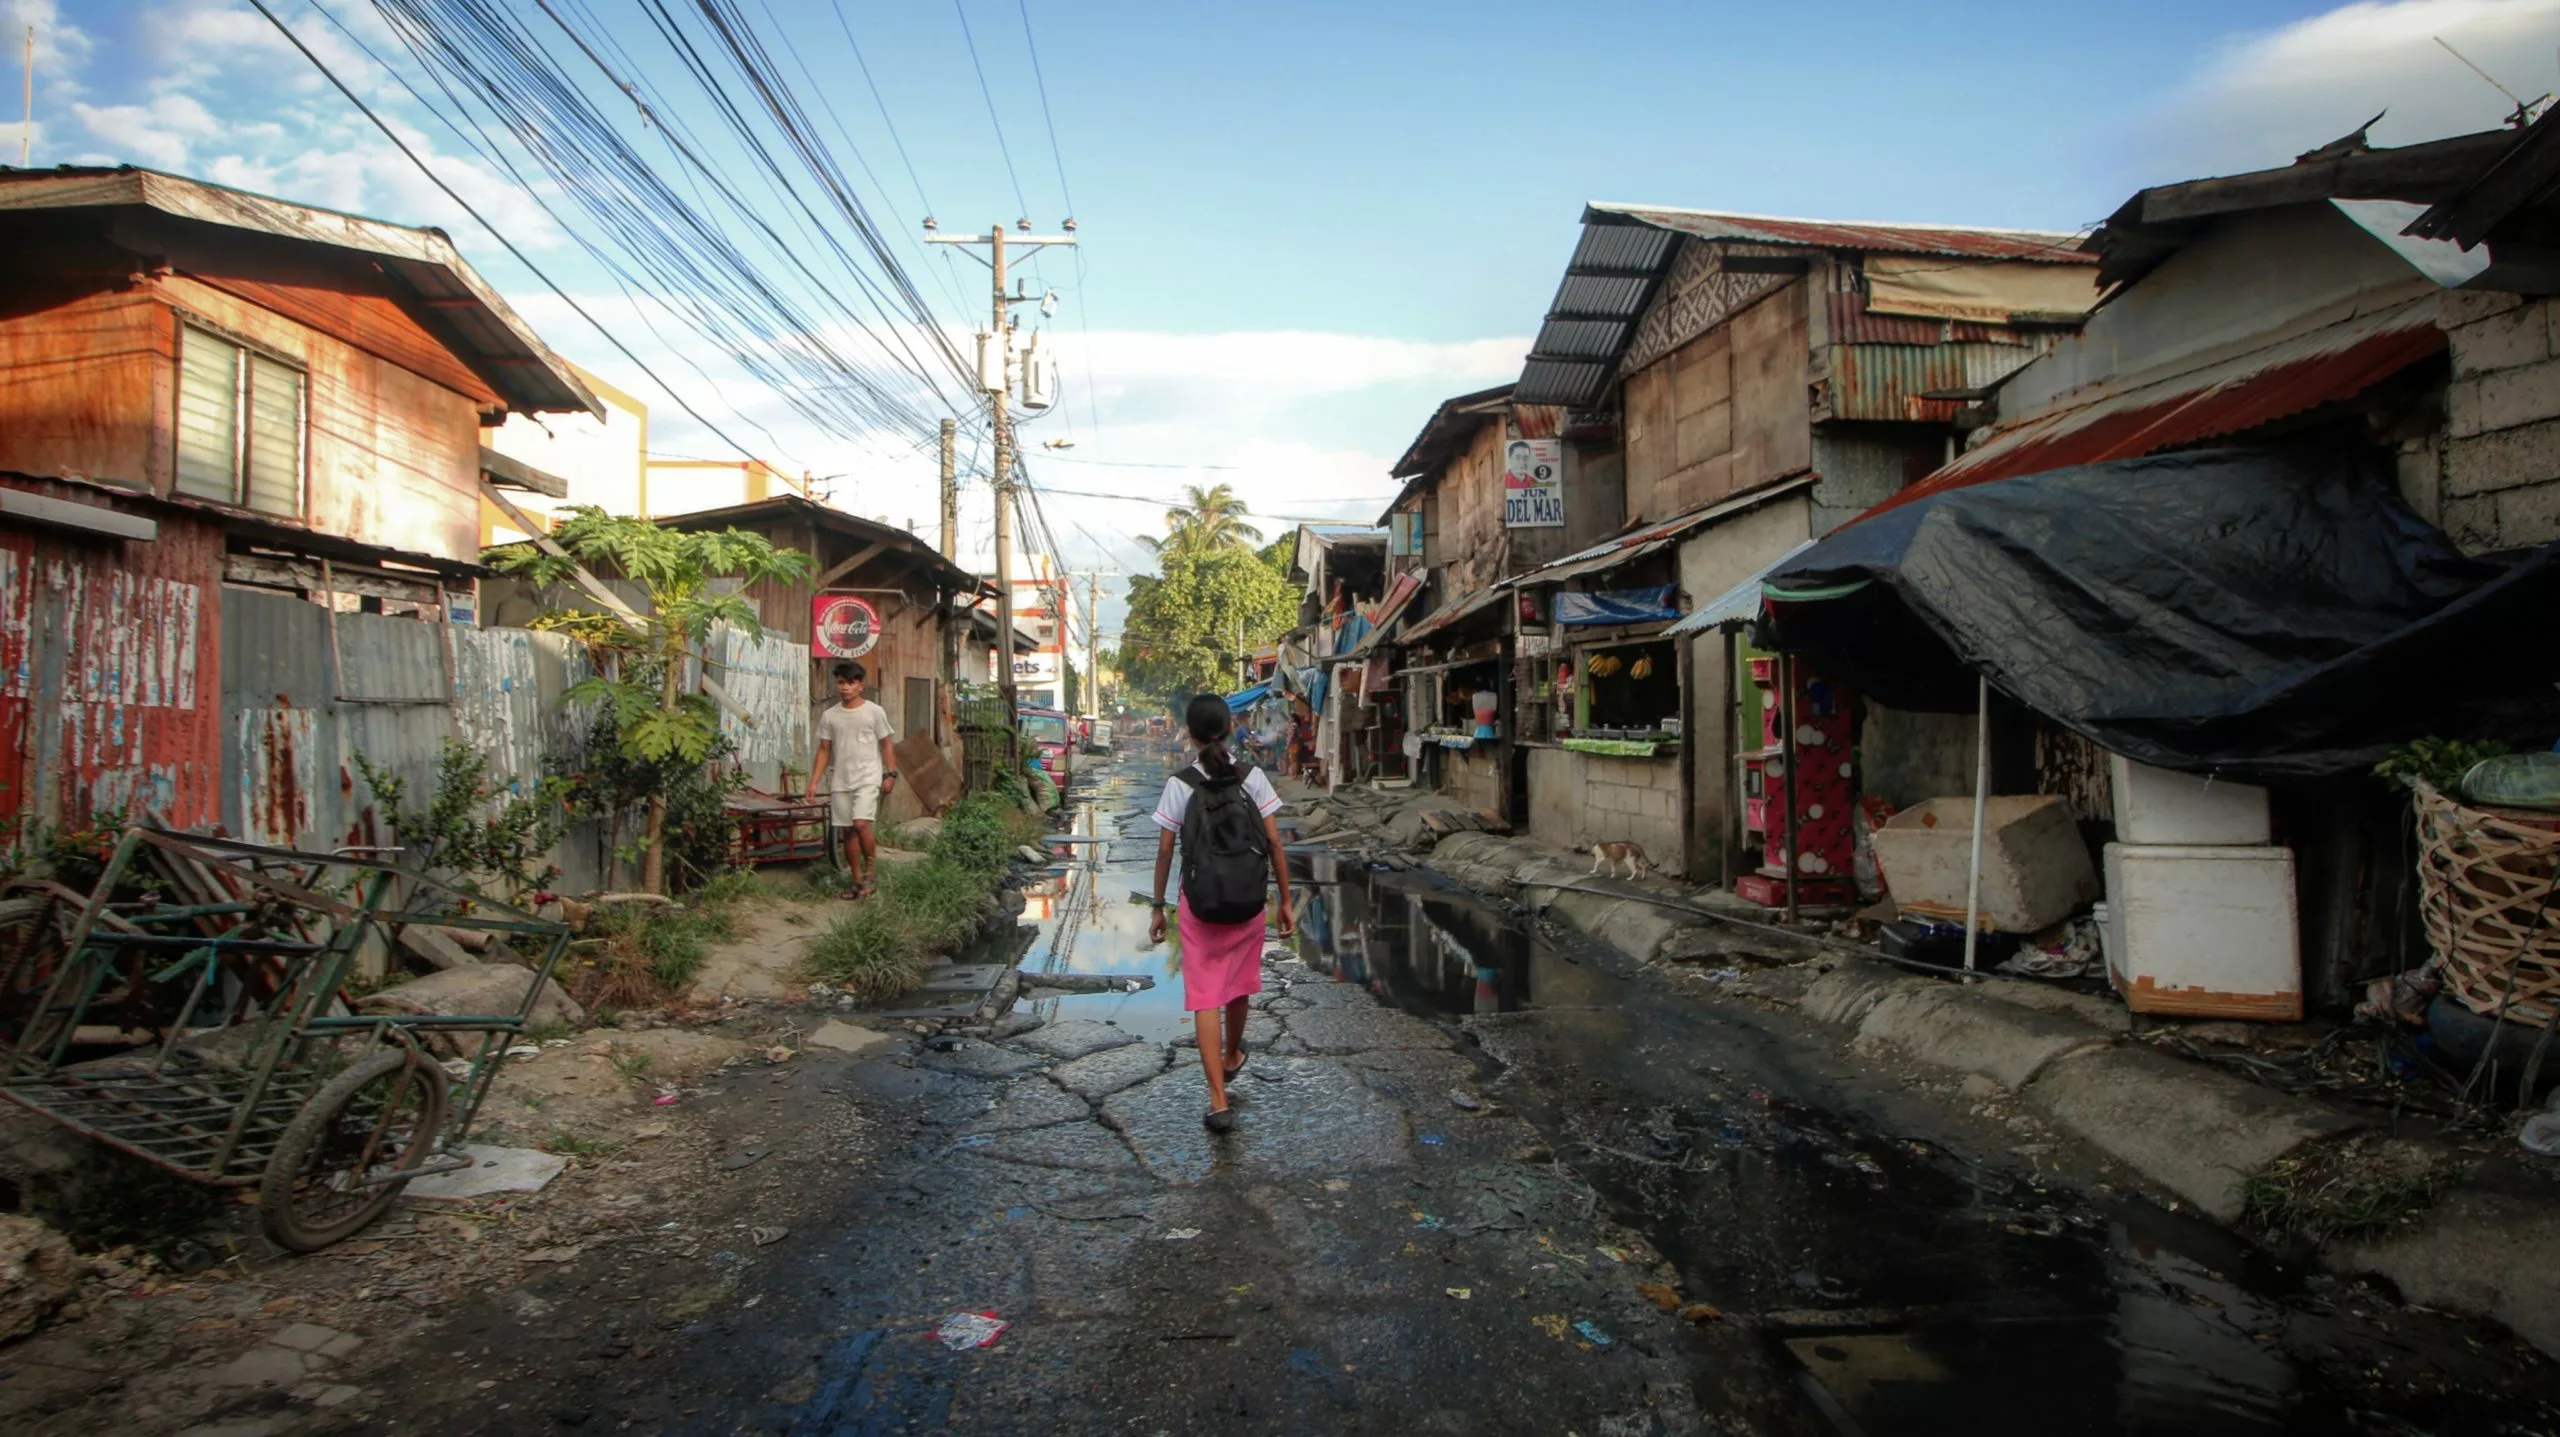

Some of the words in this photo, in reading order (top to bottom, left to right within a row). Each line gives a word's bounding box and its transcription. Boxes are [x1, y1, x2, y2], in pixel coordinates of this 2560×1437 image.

[1539, 466, 1547, 478] 9
[1521, 488, 1547, 498] JUN
[1507, 498, 1531, 523] DEL
[1533, 497, 1562, 522] MAR
[1012, 660, 1040, 674] ets
